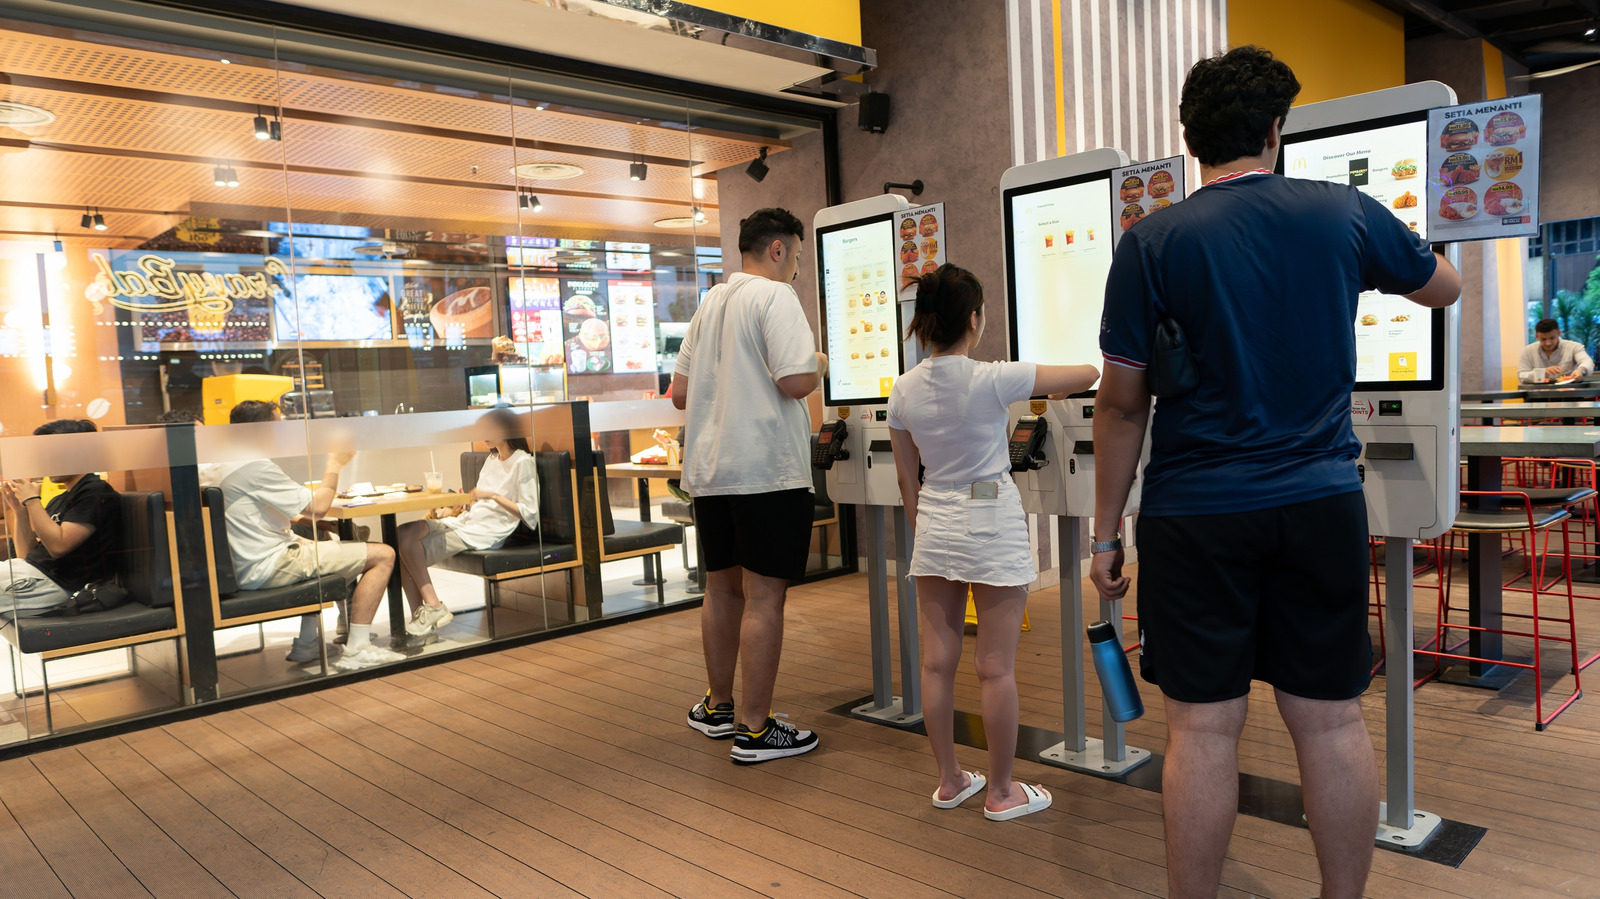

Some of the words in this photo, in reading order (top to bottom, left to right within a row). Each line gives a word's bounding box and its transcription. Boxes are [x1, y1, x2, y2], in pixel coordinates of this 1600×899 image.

[1444, 109, 1473, 119] SETIA
[1475, 102, 1522, 115] MENANTI
[1504, 152, 1523, 165] RM1
[1122, 169, 1140, 177] SETIA
[1141, 162, 1172, 174] MENANTI
[914, 207, 936, 216] MENANTI
[842, 236, 858, 244] Burgers
[764, 727, 792, 747] AX
